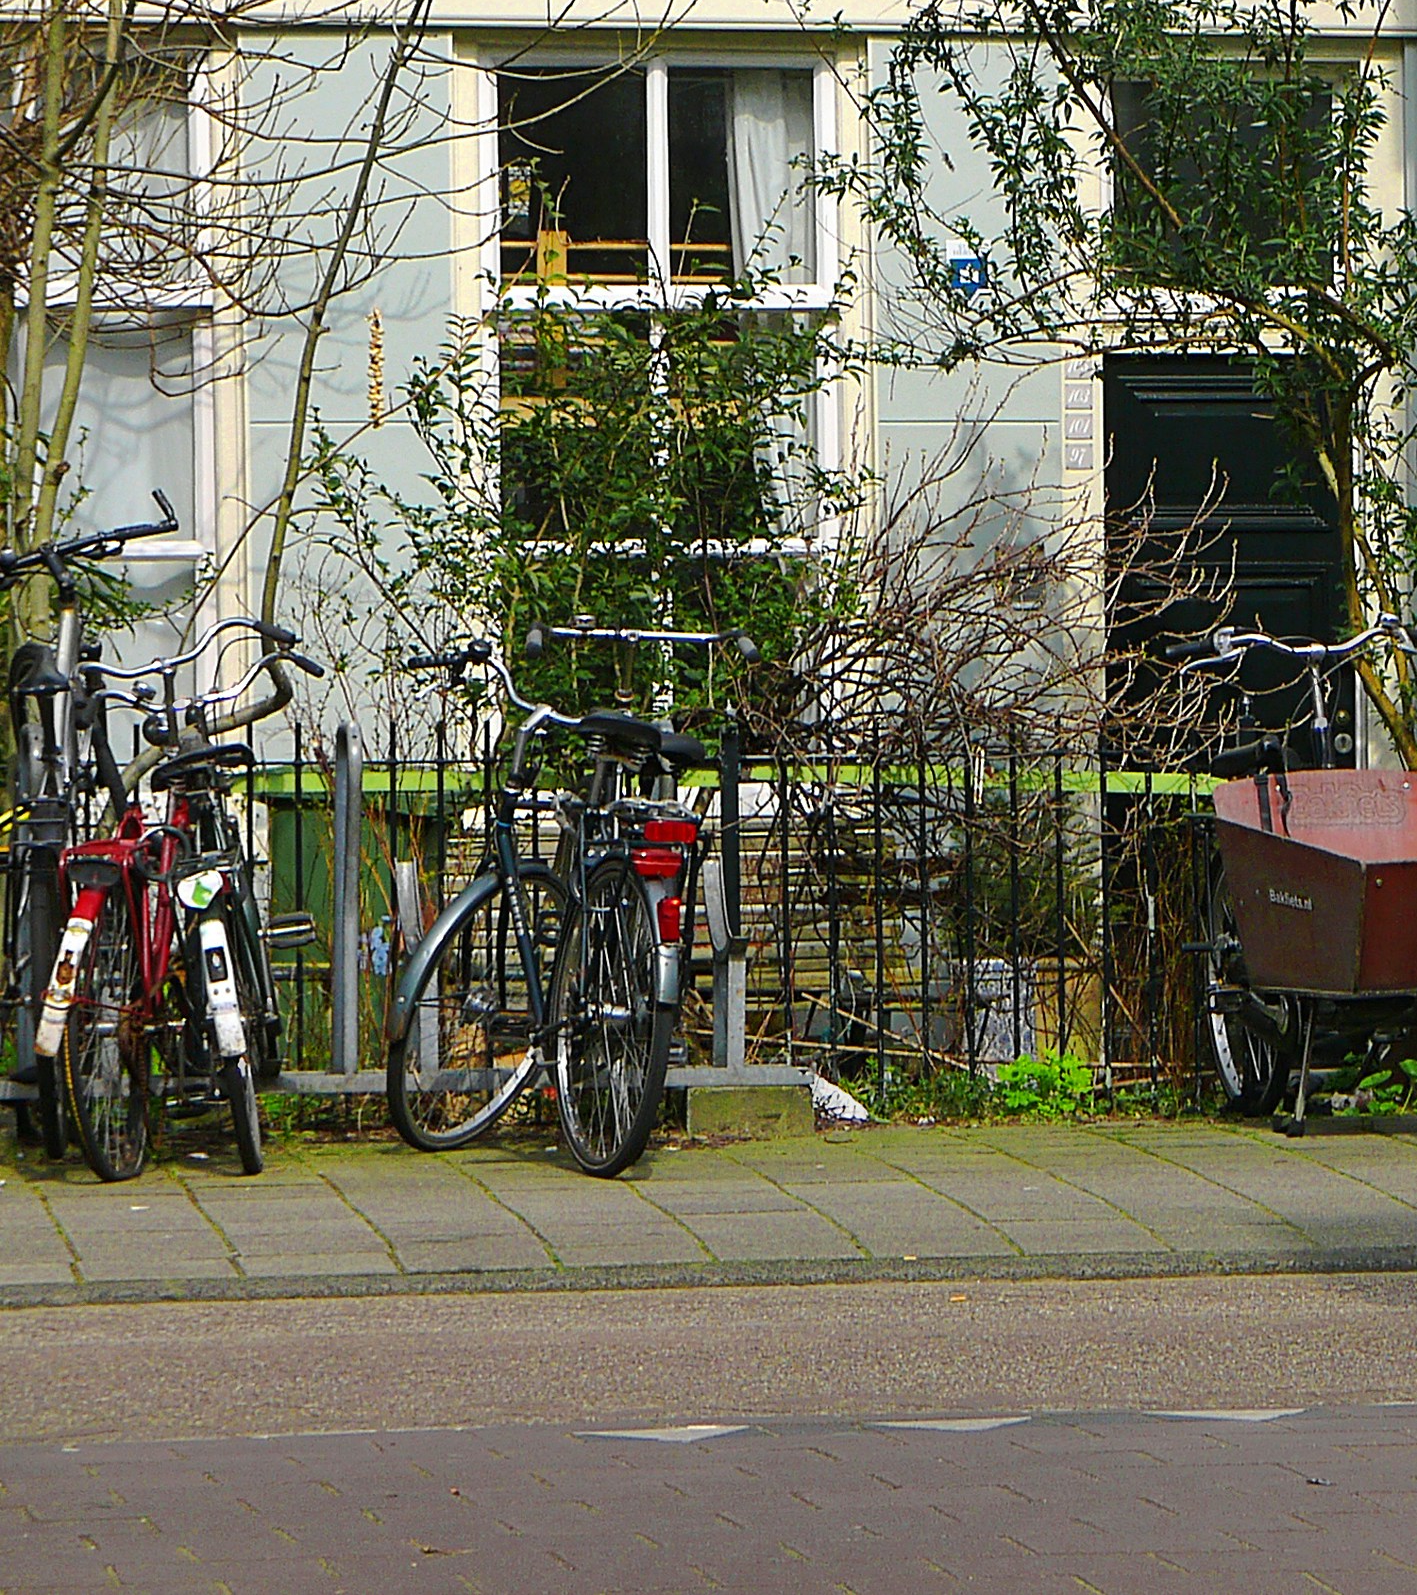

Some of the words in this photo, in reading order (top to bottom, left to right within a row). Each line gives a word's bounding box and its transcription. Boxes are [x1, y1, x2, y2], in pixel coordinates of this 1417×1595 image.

[1068, 388, 1091, 404] 103
[1068, 418, 1091, 435] 101
[1070, 448, 1087, 466] 97
